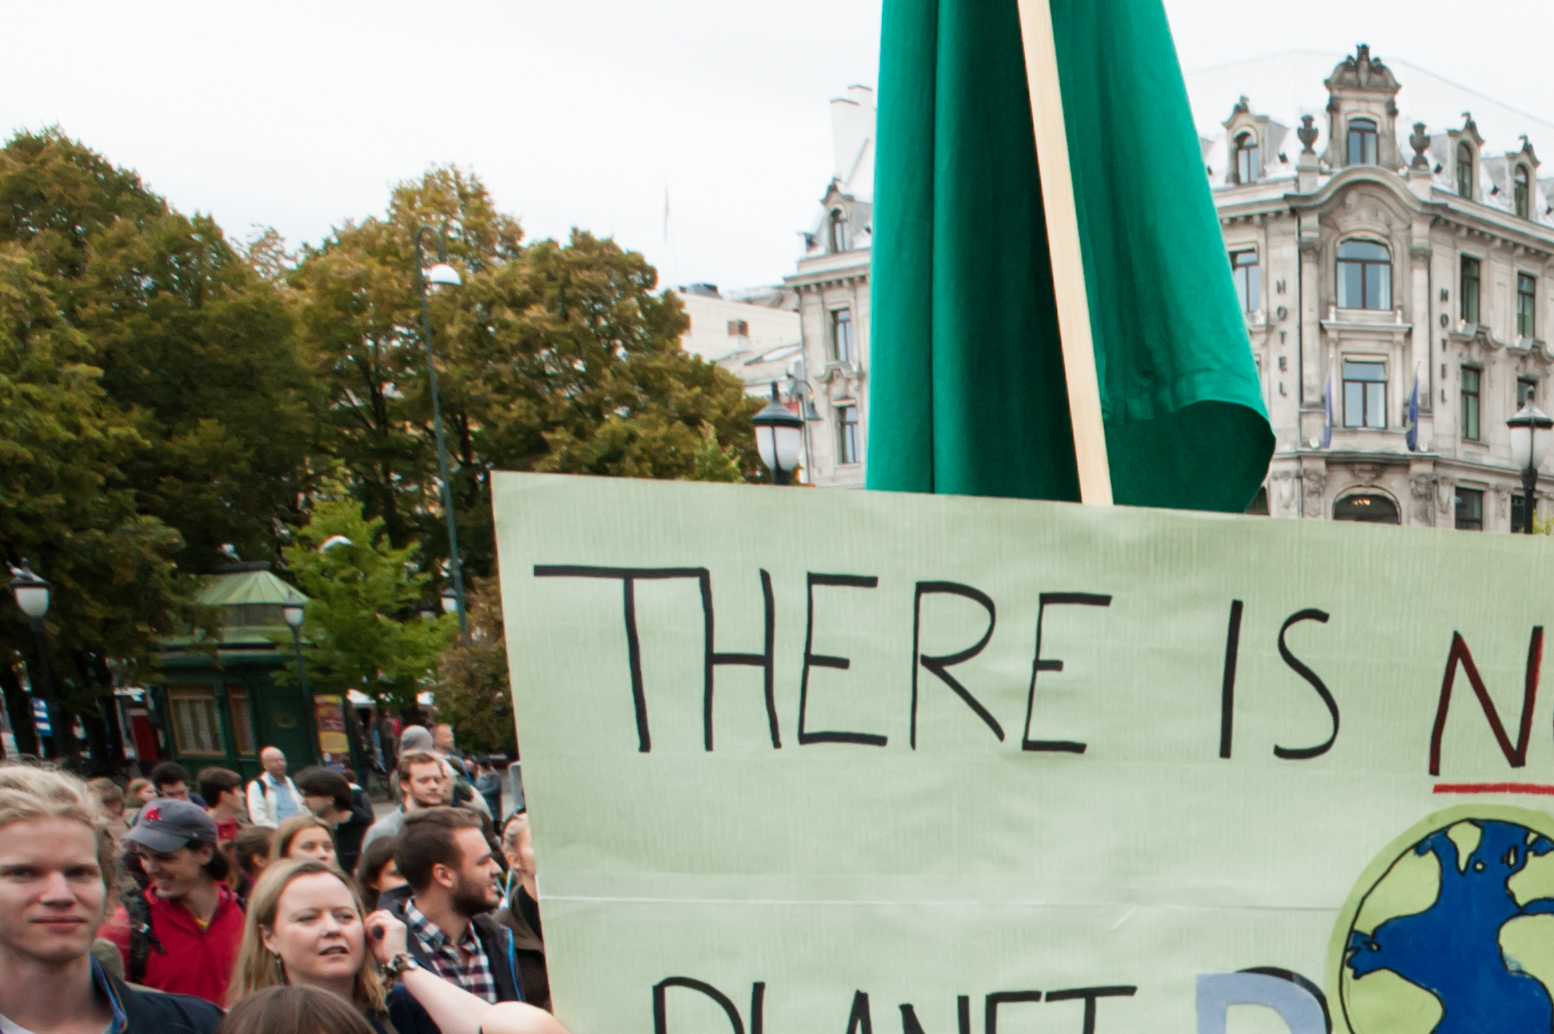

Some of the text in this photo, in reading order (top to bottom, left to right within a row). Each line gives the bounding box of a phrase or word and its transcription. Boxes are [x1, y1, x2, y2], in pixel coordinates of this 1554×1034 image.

[1276, 279, 1288, 398] HOTEL
[1439, 288, 1449, 404] HOTEL
[534, 564, 1113, 753] THERE
[1219, 598, 1340, 760] IS
